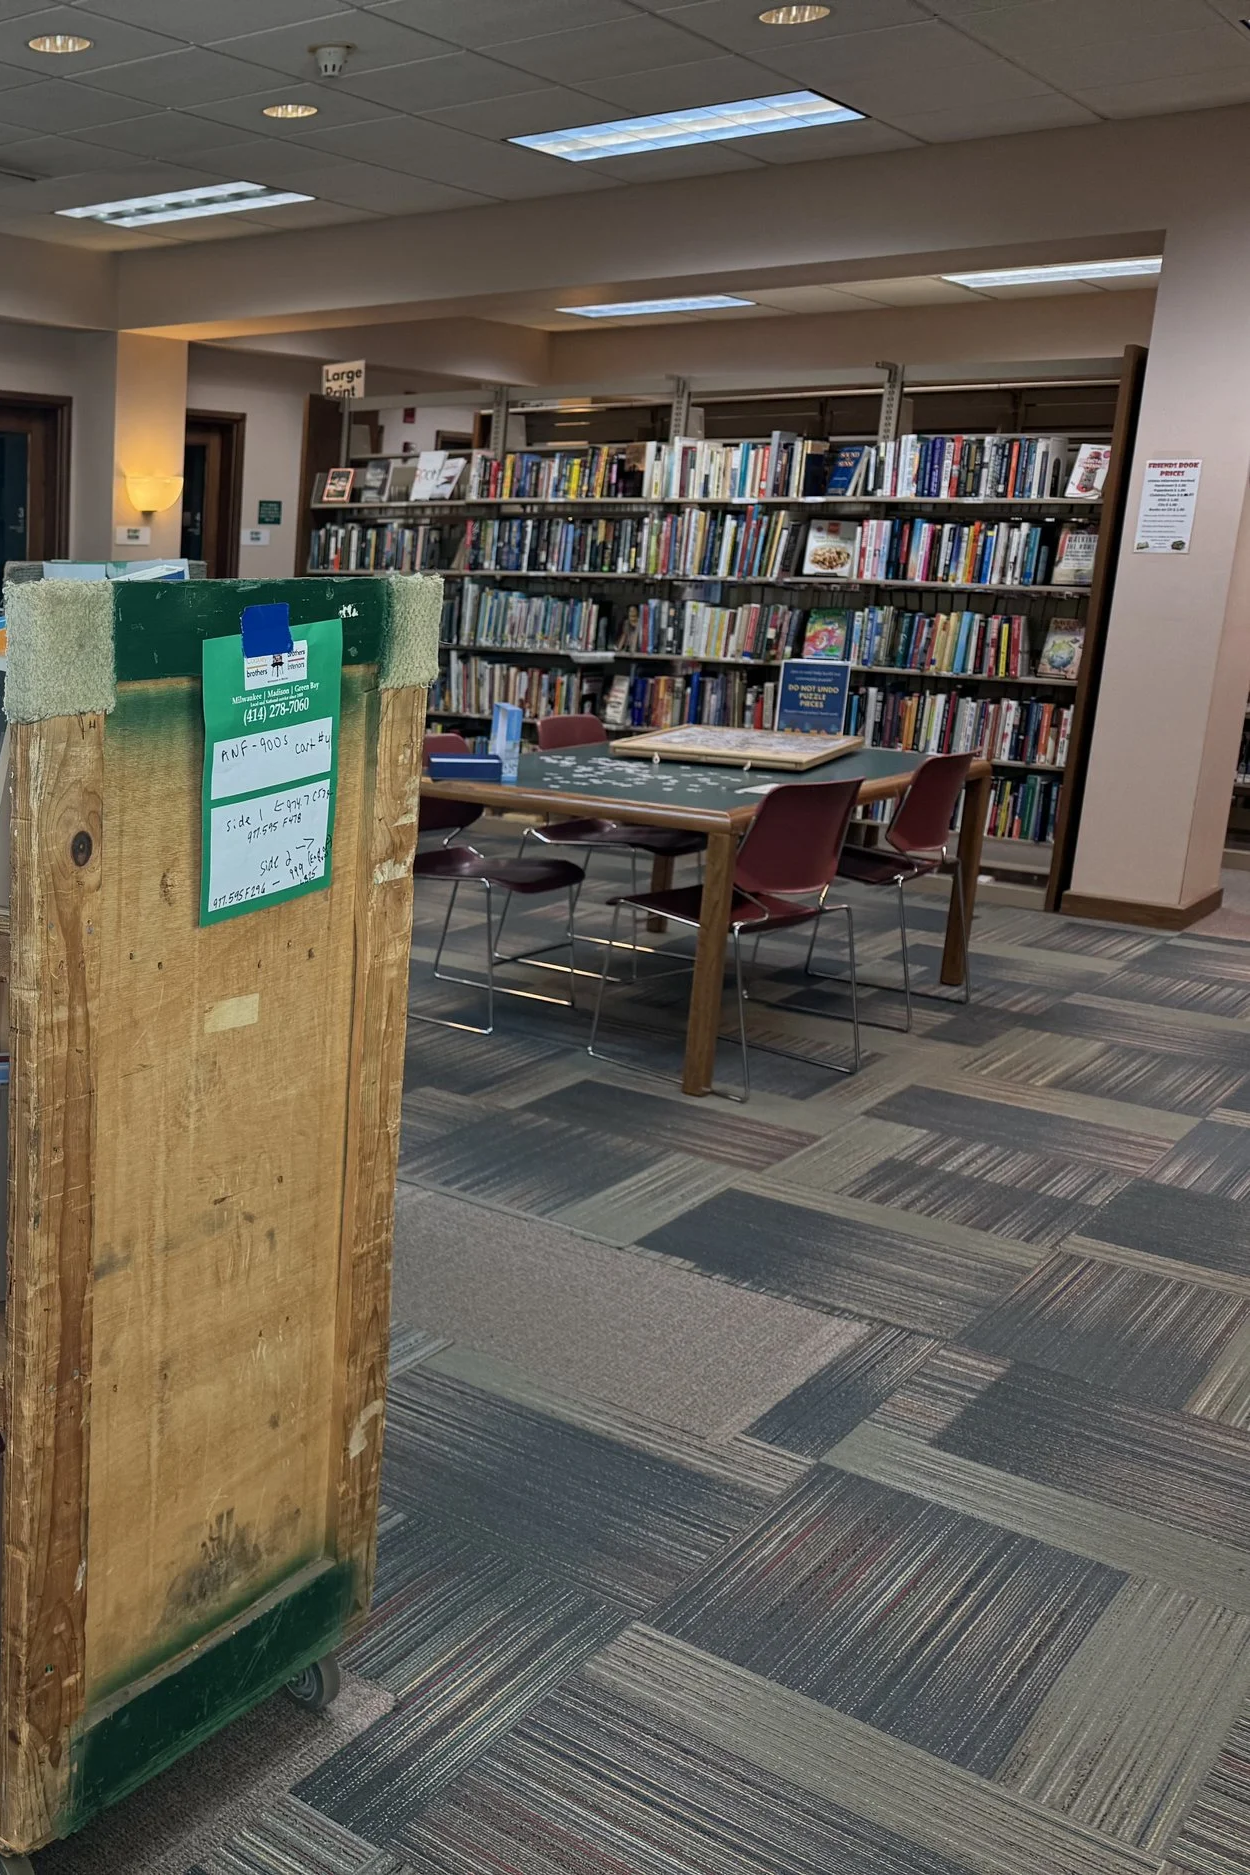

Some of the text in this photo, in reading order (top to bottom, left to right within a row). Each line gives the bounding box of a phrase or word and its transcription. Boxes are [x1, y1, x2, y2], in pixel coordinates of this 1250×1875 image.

[325, 369, 362, 383] Large
[247, 669, 268, 678] brothers
[232, 681, 320, 704] Milwaukee Madison Green Bay
[800, 684, 816, 692] NOT
[817, 685, 839, 693] UNDO
[799, 700, 824, 708] PIECES
[243, 697, 309, 726] (414) 278-7060
